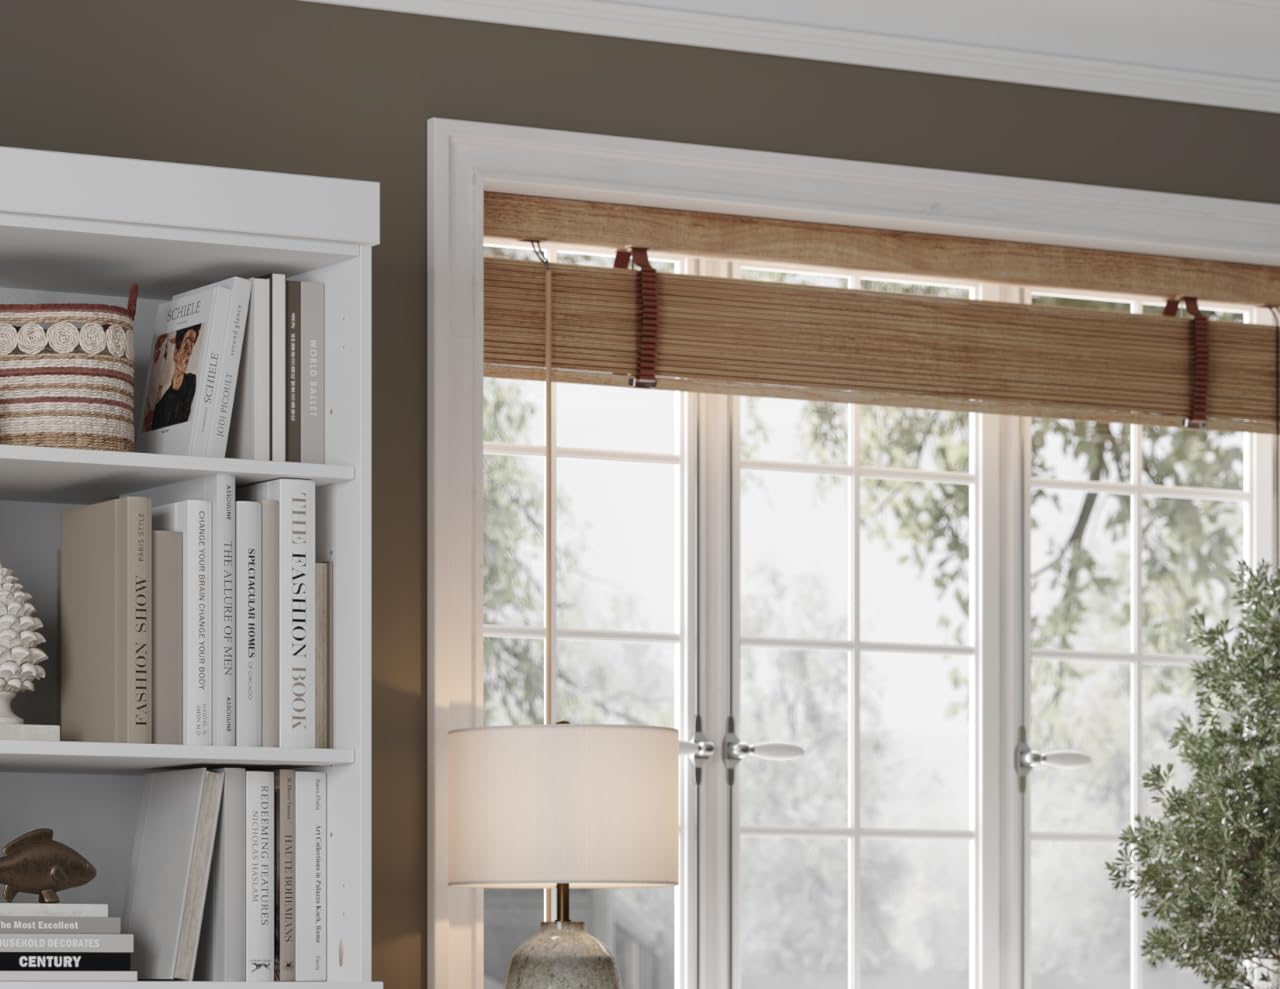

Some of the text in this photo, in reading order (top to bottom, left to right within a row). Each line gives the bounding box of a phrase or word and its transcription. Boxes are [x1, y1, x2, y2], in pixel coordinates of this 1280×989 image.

[167, 300, 201, 322] SCHIELE
[204, 352, 219, 404] SCHIELE
[223, 542, 232, 568] THE
[198, 511, 206, 691] CHANGE YOUR BRAIN CHANGE YOUR BODY
[223, 570, 232, 623] ALLURE
[247, 548, 256, 620] SPECTACULAR
[223, 626, 232, 643] OF
[292, 492, 306, 729] THE FASHION BOOK
[136, 576, 148, 728] FASHION SHOW
[223, 646, 232, 676] MEN
[247, 623, 256, 658] HOMES
[261, 786, 270, 926] REDEEMING FEATURES
[285, 835, 293, 943] HAUTE BOHEMIANS
[14, 921, 36, 929] Most
[38, 922, 79, 930] Excellent
[18, 955, 81, 968] CENTURY
